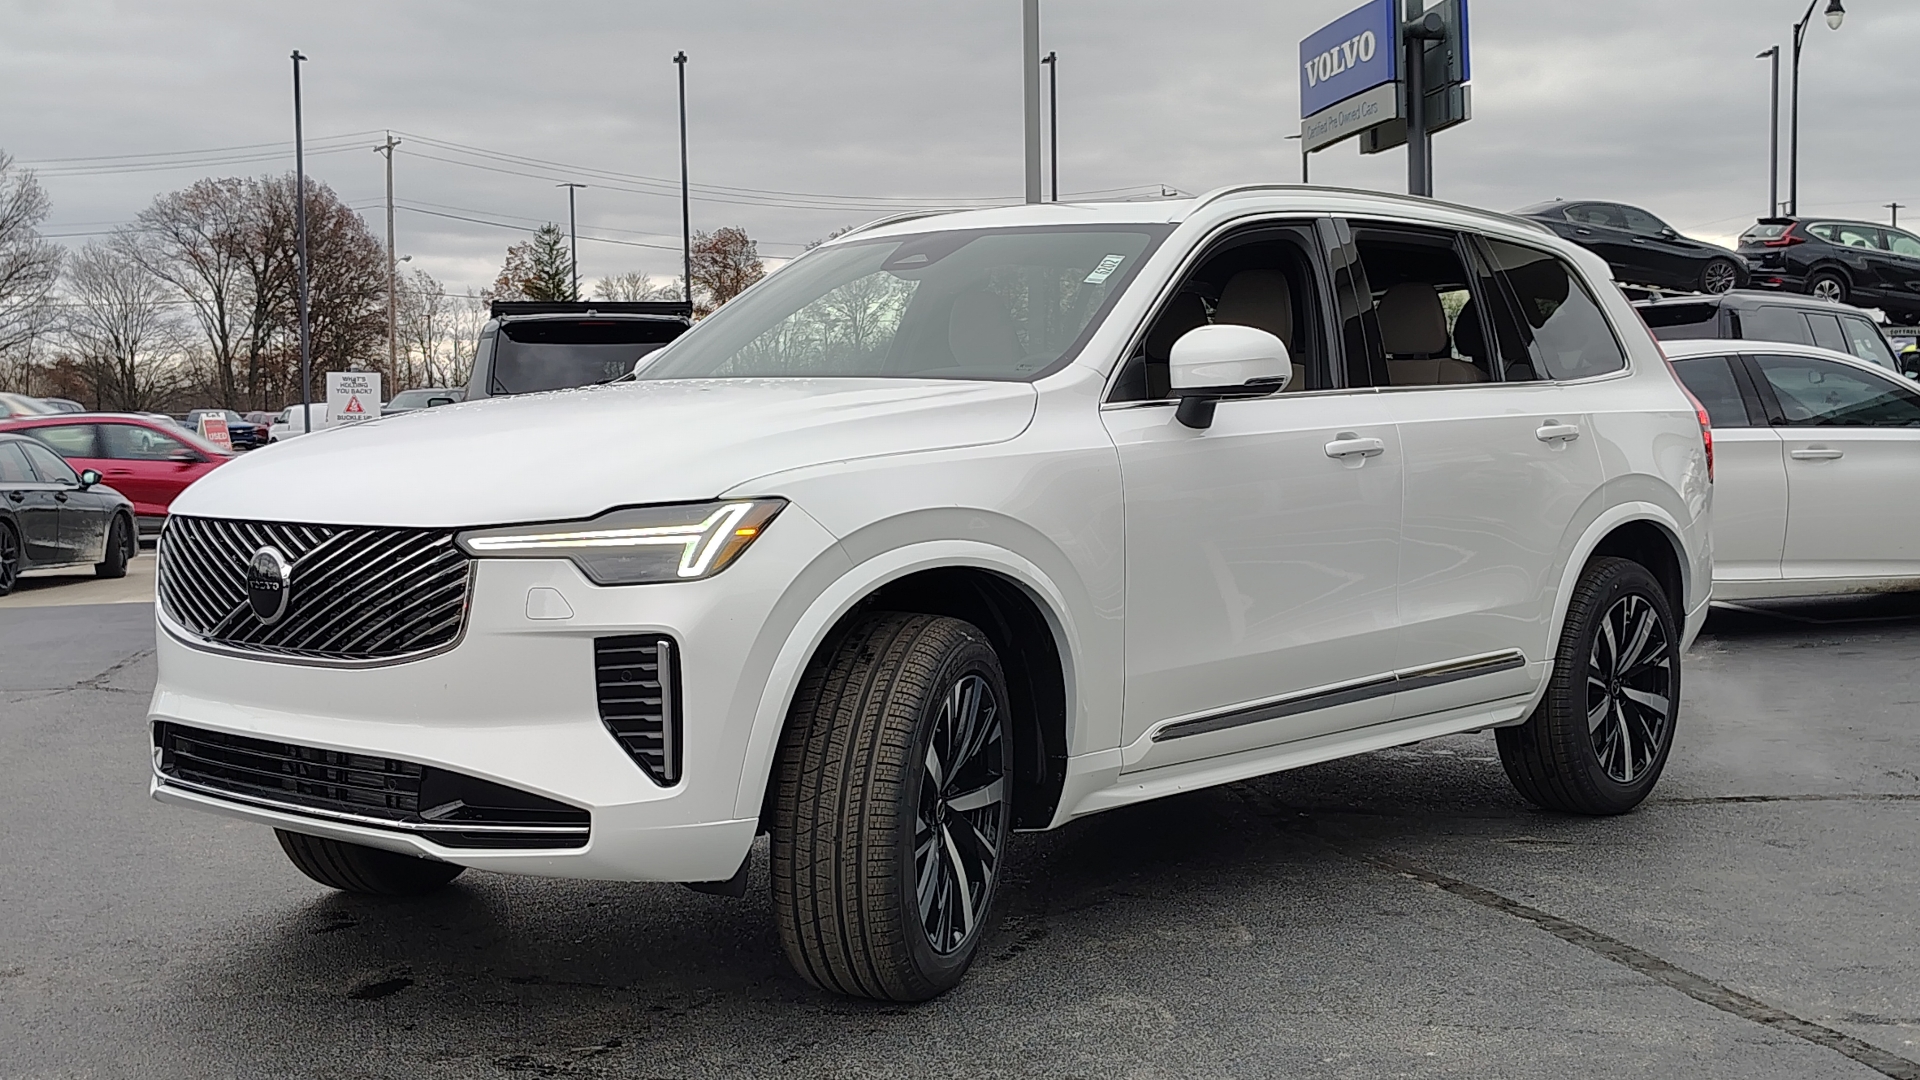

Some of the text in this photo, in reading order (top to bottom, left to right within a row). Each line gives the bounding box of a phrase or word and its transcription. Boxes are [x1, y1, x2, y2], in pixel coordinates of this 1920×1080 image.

[1304, 30, 1376, 88] VOLVO
[1307, 101, 1378, 140] Certified Pre Owned Cars
[208, 432, 228, 440] USED
